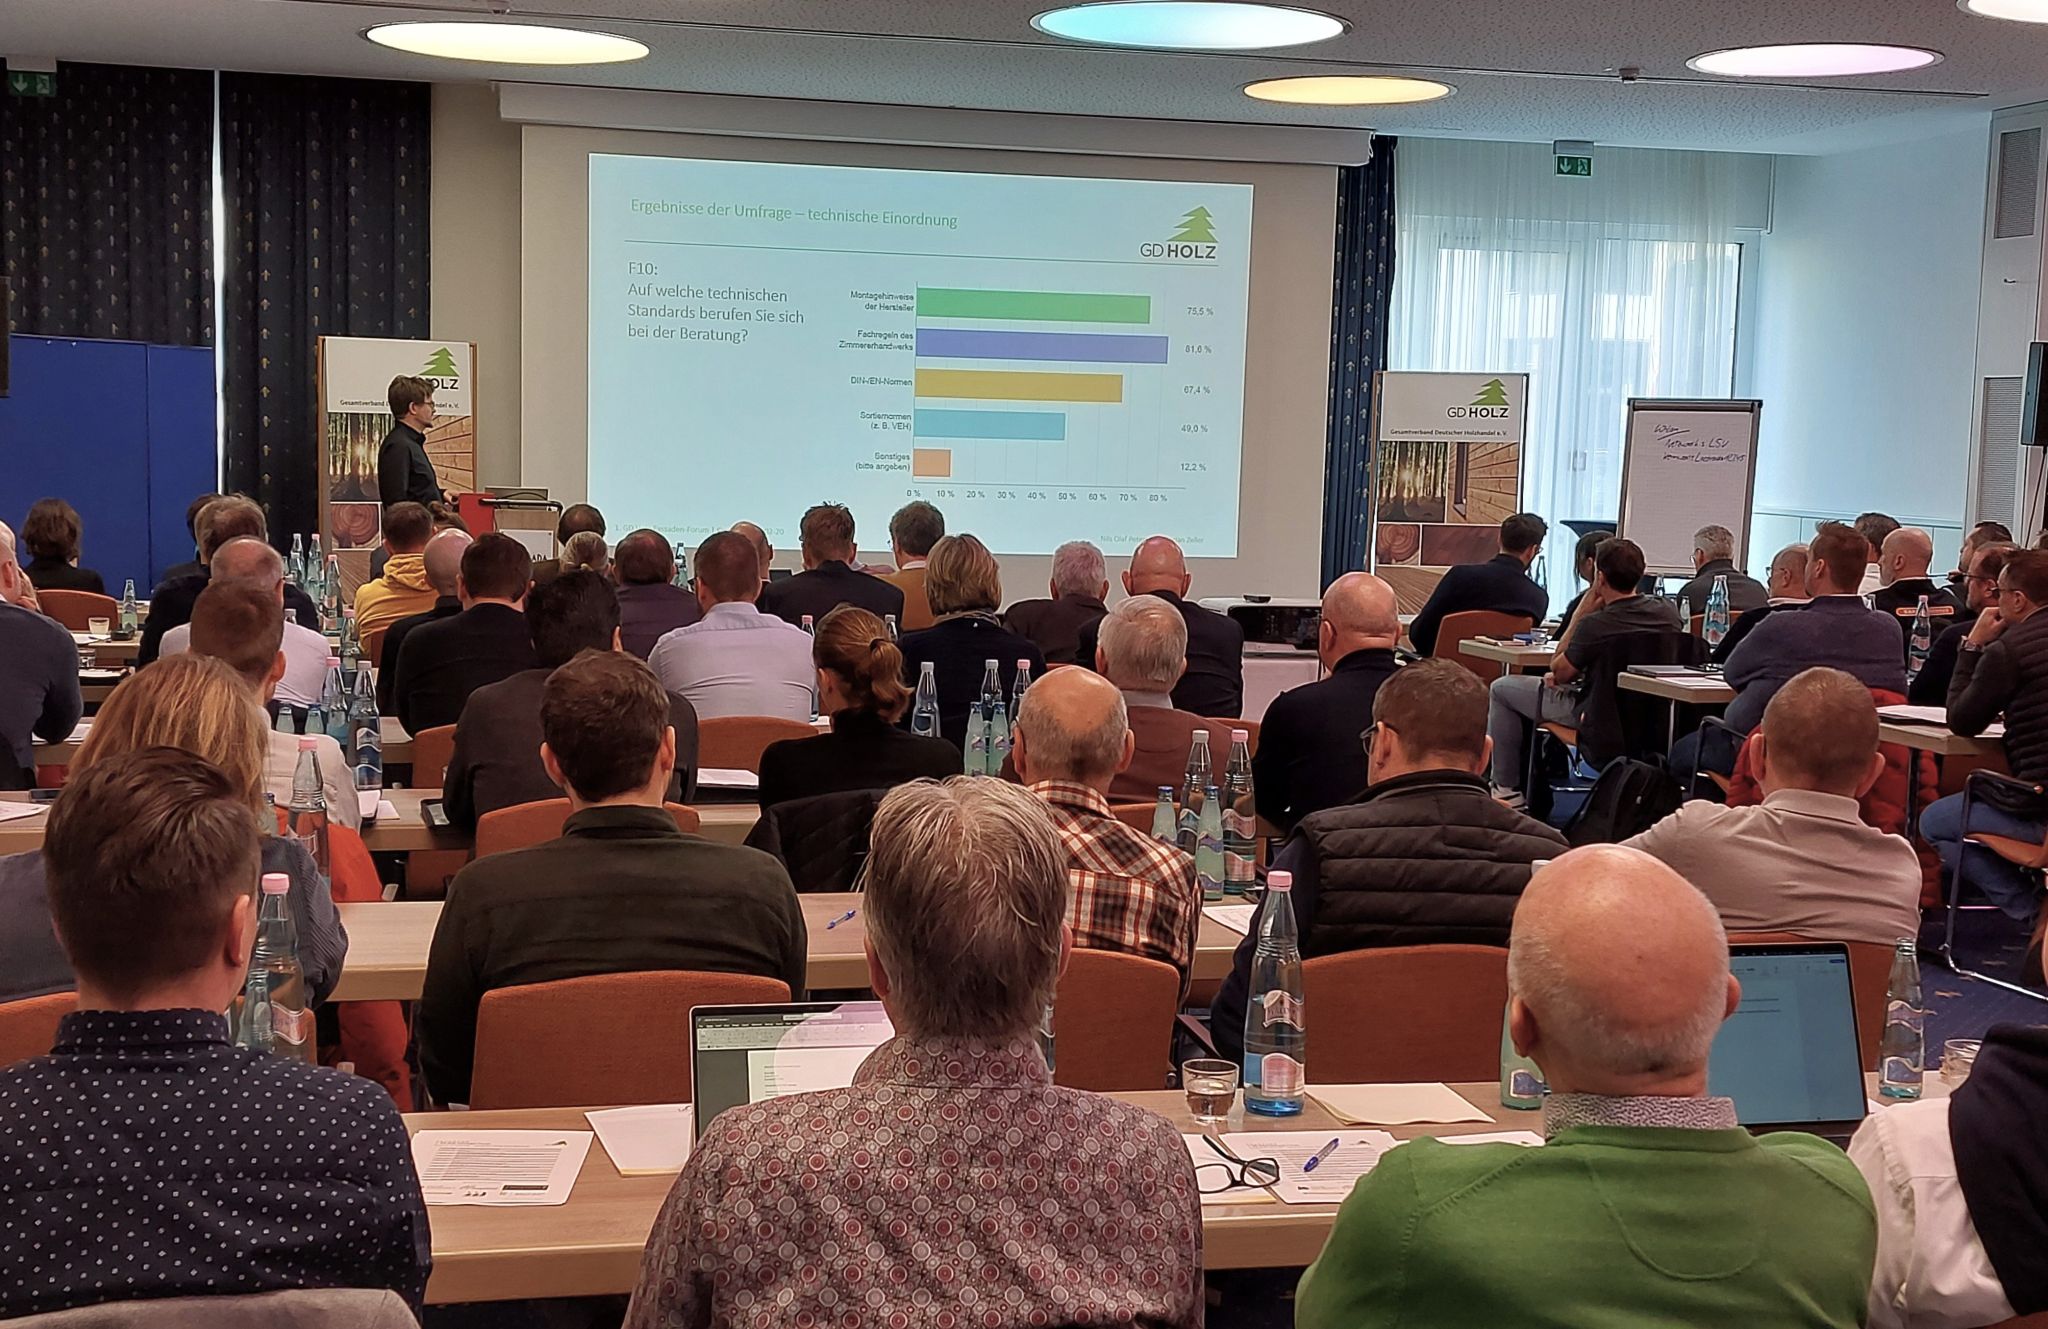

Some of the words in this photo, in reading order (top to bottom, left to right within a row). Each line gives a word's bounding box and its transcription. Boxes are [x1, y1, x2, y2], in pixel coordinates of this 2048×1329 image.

[630, 199, 704, 218] Ergebnisse
[707, 202, 732, 217] der
[734, 204, 793, 221] Umfrage
[807, 208, 879, 224] technische
[882, 211, 959, 230] Einordnung
[1140, 243, 1164, 258] GD
[1167, 243, 1217, 259] HOLZ
[628, 261, 659, 277] F10:
[627, 283, 653, 298] Auf
[655, 284, 704, 300] welche
[707, 286, 788, 303] technischen
[864, 302, 878, 311] der
[1187, 306, 1205, 316] 75,5
[627, 304, 696, 320] Standards
[699, 306, 752, 323] berufen
[755, 308, 776, 323] Sie
[778, 309, 805, 325] sich
[627, 323, 650, 339] bei
[652, 325, 677, 340] der
[679, 327, 748, 344] Beratung?
[900, 331, 914, 340] des
[426, 377, 459, 390] OLZ
[1447, 406, 1467, 418] GD
[1468, 407, 1509, 418] HOLZ
[1390, 428, 1433, 436] Gesamtverband
[874, 452, 910, 462] Sonstiges
[1180, 463, 1198, 472] 12,2
